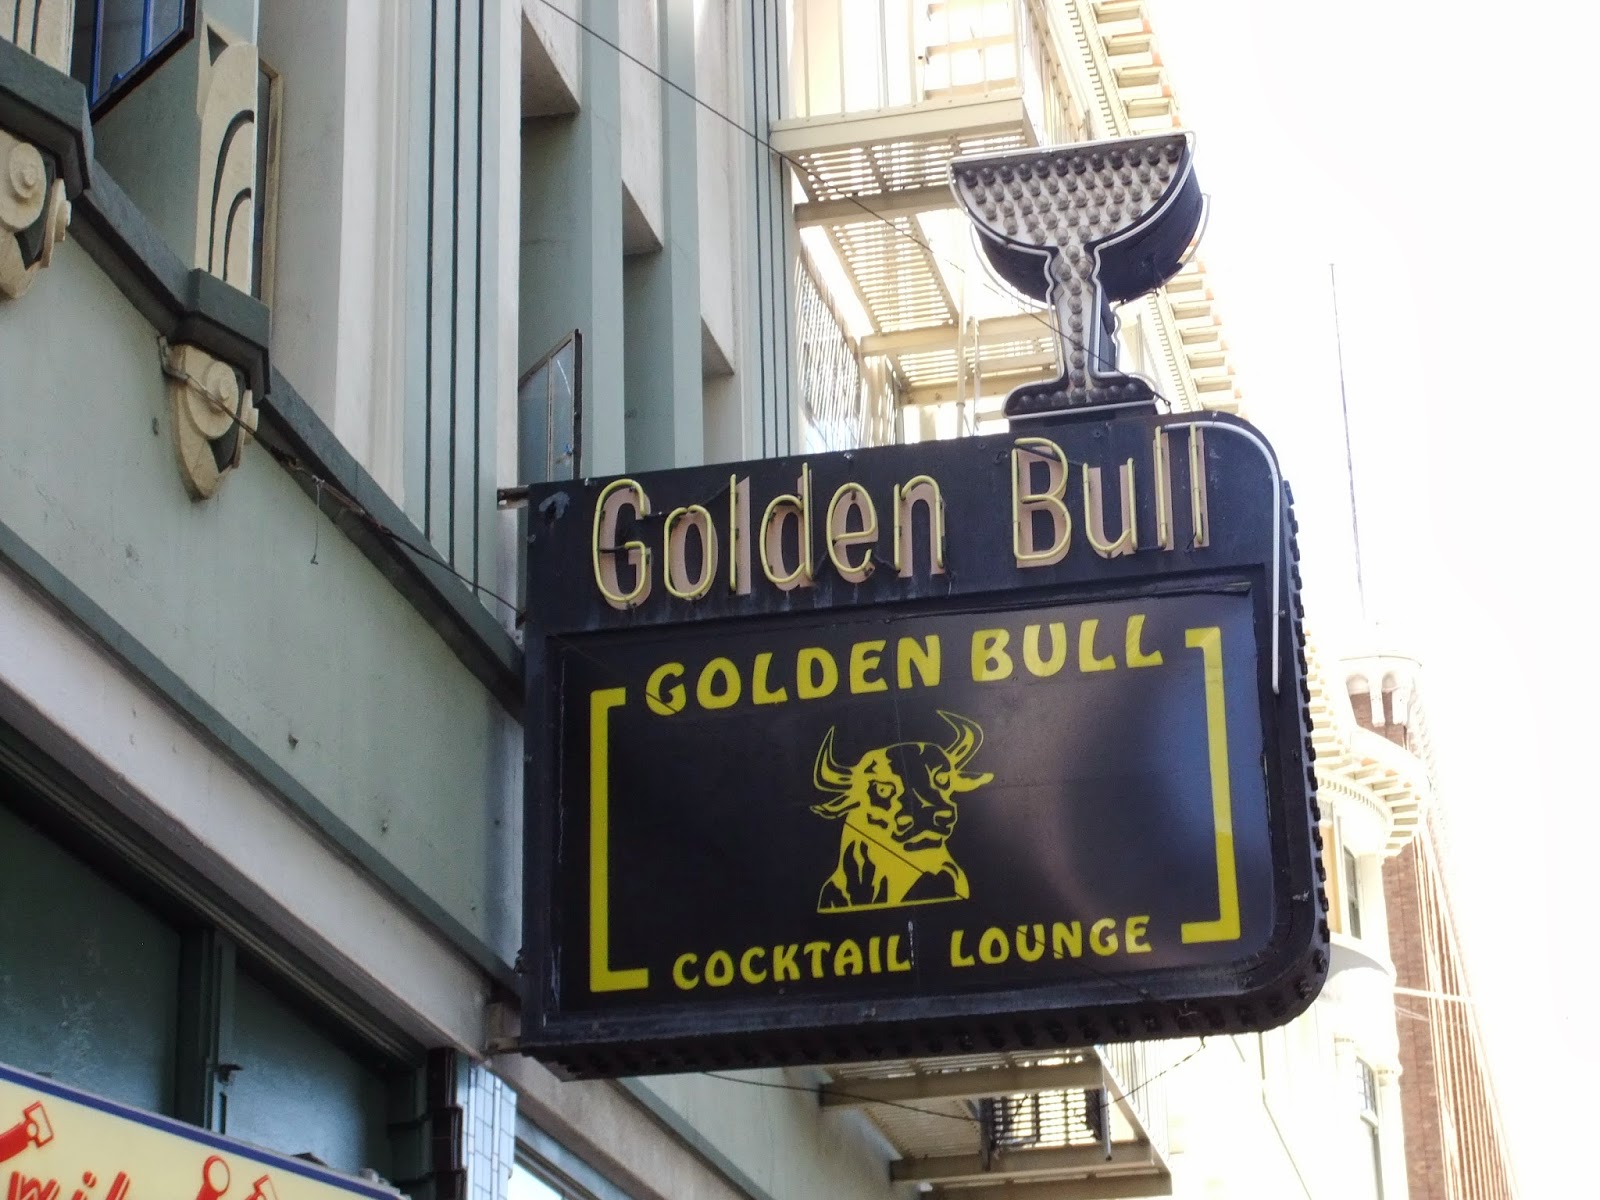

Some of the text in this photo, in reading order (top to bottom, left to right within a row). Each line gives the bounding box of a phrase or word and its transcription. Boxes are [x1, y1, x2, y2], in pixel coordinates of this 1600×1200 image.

[593, 423, 1210, 611] Golden Bull
[645, 614, 1164, 716] GOLDEN BULL
[672, 915, 1152, 990] COCKTAIL LOUNGE
